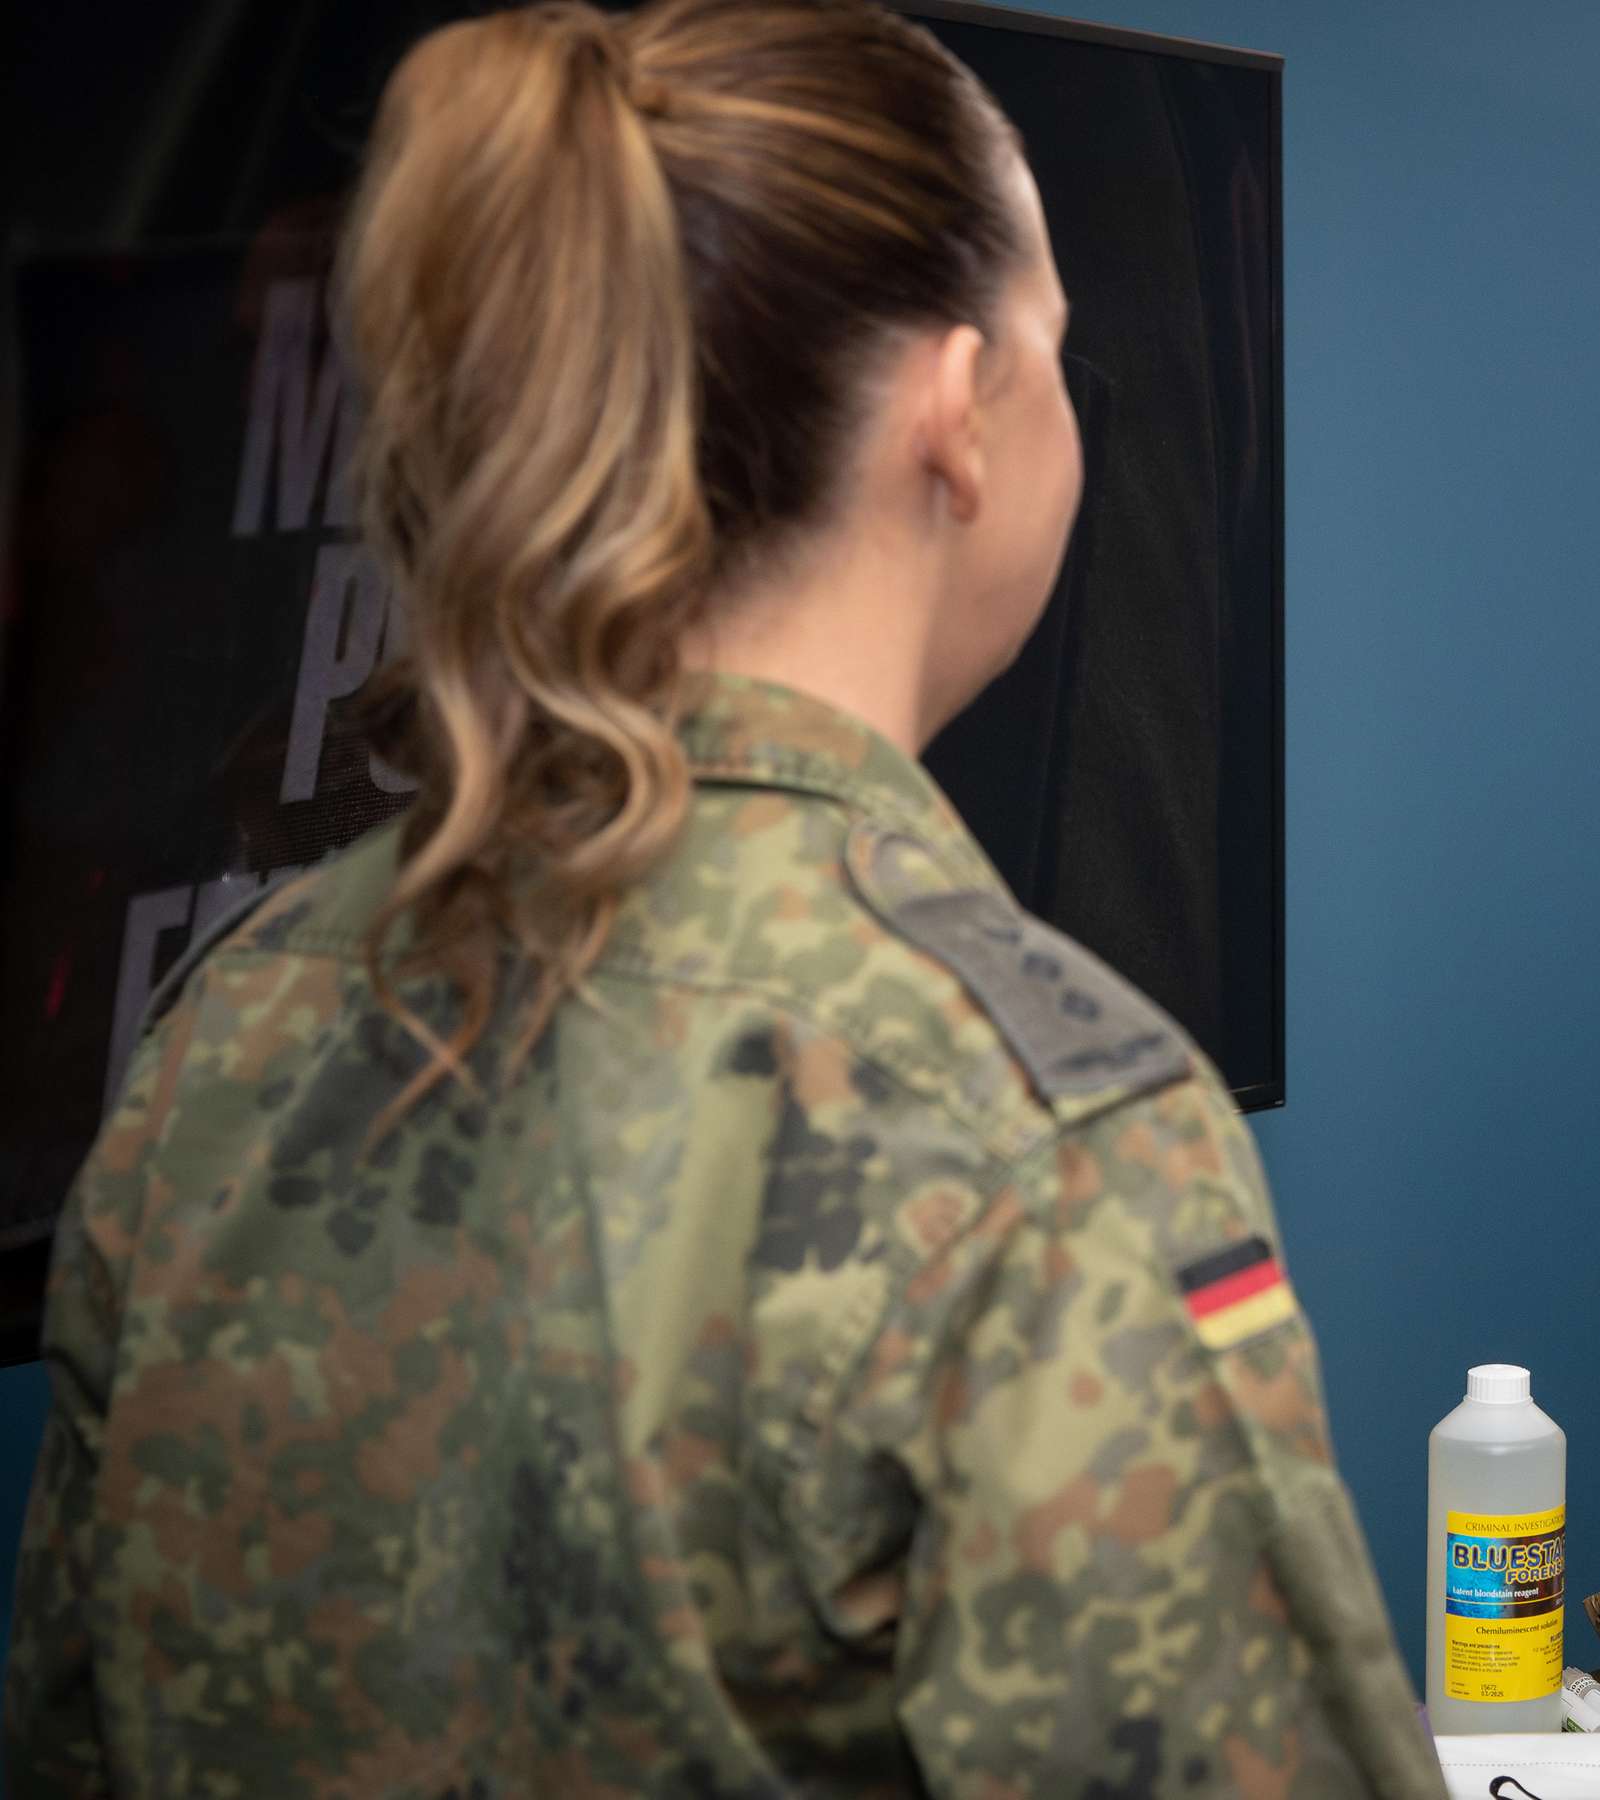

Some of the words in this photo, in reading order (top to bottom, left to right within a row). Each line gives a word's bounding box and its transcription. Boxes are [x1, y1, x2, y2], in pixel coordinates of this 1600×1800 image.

[1465, 1521, 1512, 1533] CRIMINAL
[1453, 1536, 1564, 1572] BLUESTA
[1506, 1560, 1563, 1585] FORENS
[1452, 1585, 1473, 1597] Latent
[1514, 1587, 1539, 1599] reagent
[1475, 1623, 1539, 1635] Chemiluminescent
